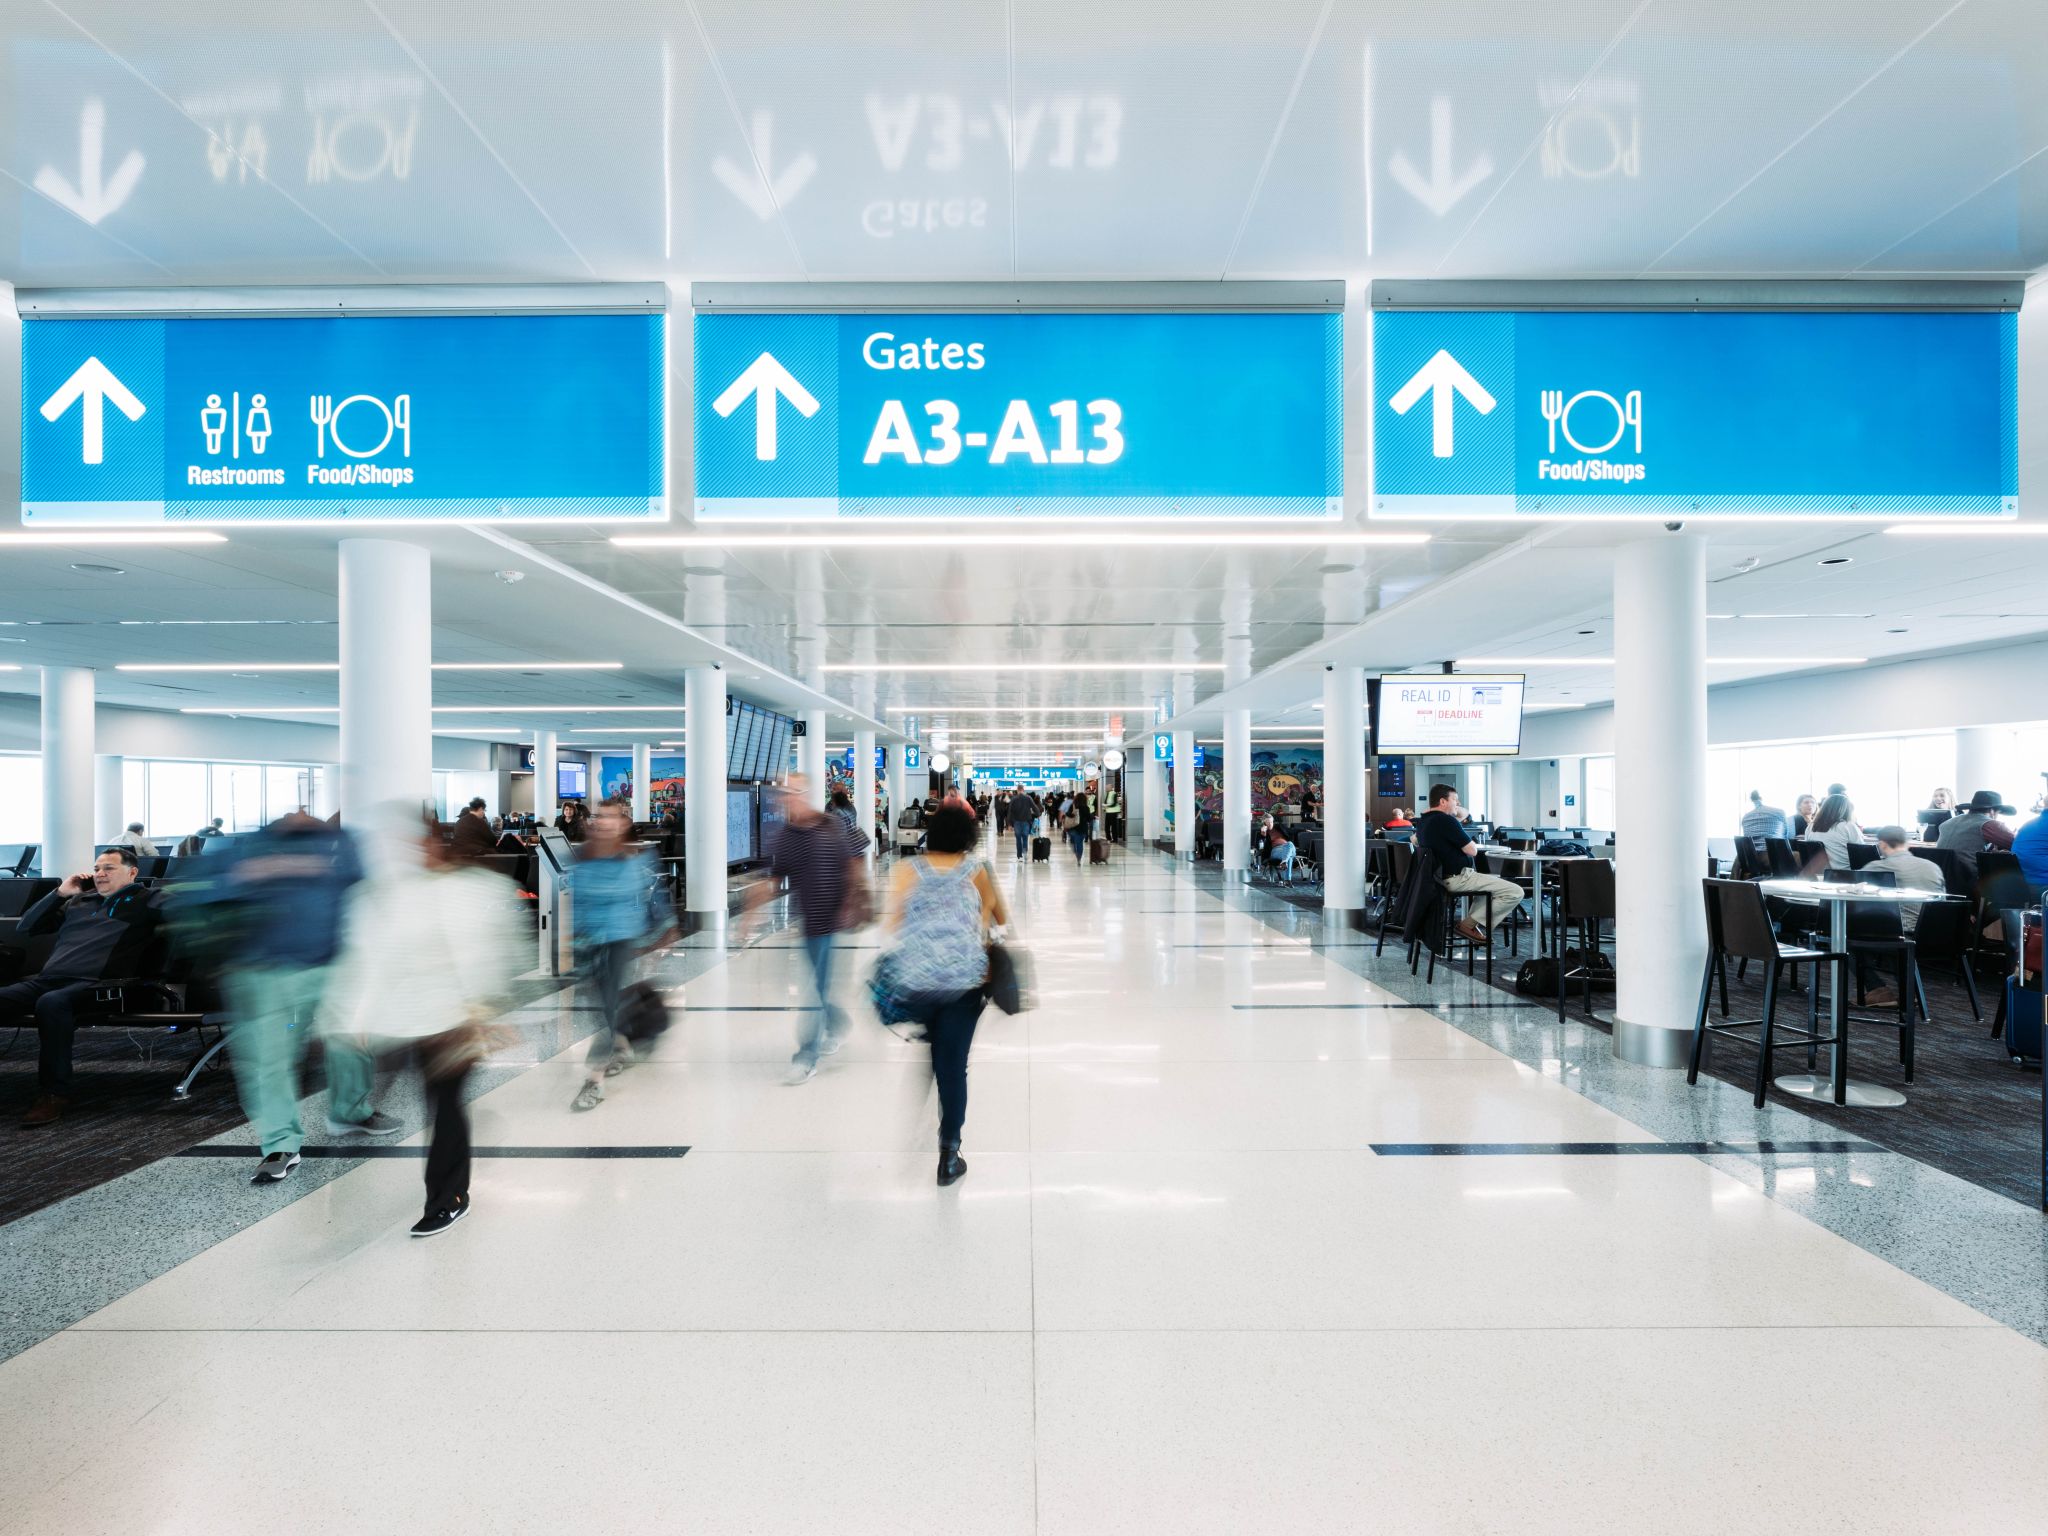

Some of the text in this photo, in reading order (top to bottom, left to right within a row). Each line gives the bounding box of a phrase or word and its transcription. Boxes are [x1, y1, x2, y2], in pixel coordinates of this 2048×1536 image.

[862, 332, 985, 370] Gates
[863, 399, 1124, 465] A3-A13
[187, 465, 285, 485] Restrooms
[307, 464, 414, 488] Food/Shops
[1538, 459, 1646, 484] Food/Shops
[1401, 689, 1451, 702] REAL ID
[1438, 710, 1483, 719] DEADLINE
[909, 757, 916, 765] 4
[1159, 748, 1167, 757] 3
